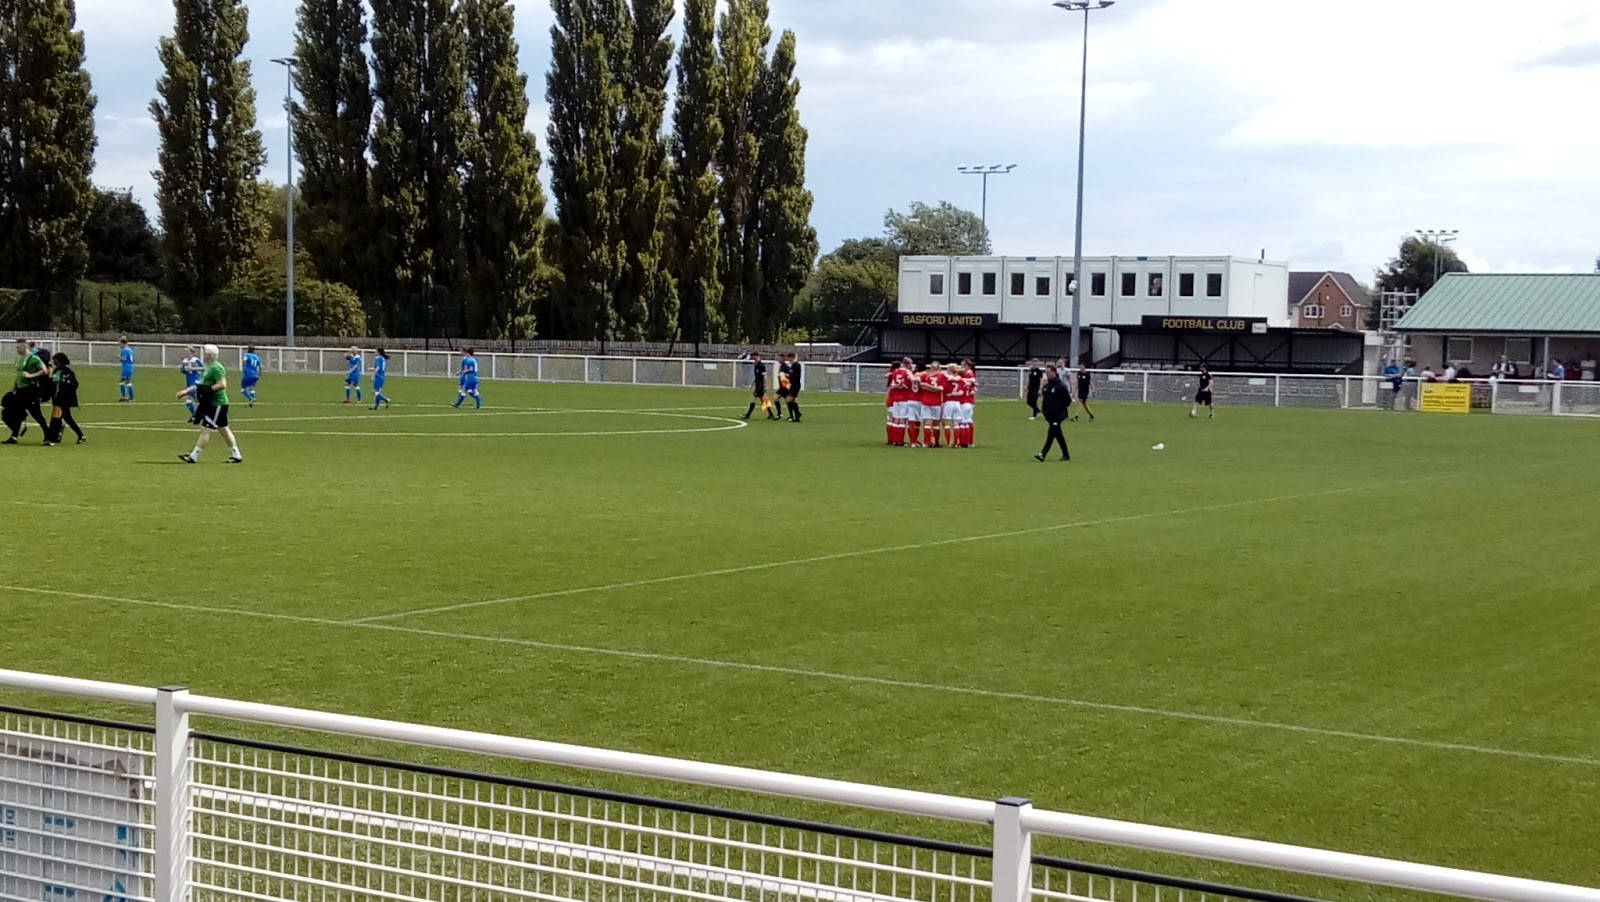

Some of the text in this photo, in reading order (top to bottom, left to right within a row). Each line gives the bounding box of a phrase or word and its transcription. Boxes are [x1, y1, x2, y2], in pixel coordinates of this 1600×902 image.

[903, 315, 982, 326] BASFORD UNITED
[1162, 319, 1246, 330] FOOTBALL CLUB
[952, 382, 960, 395] 2
